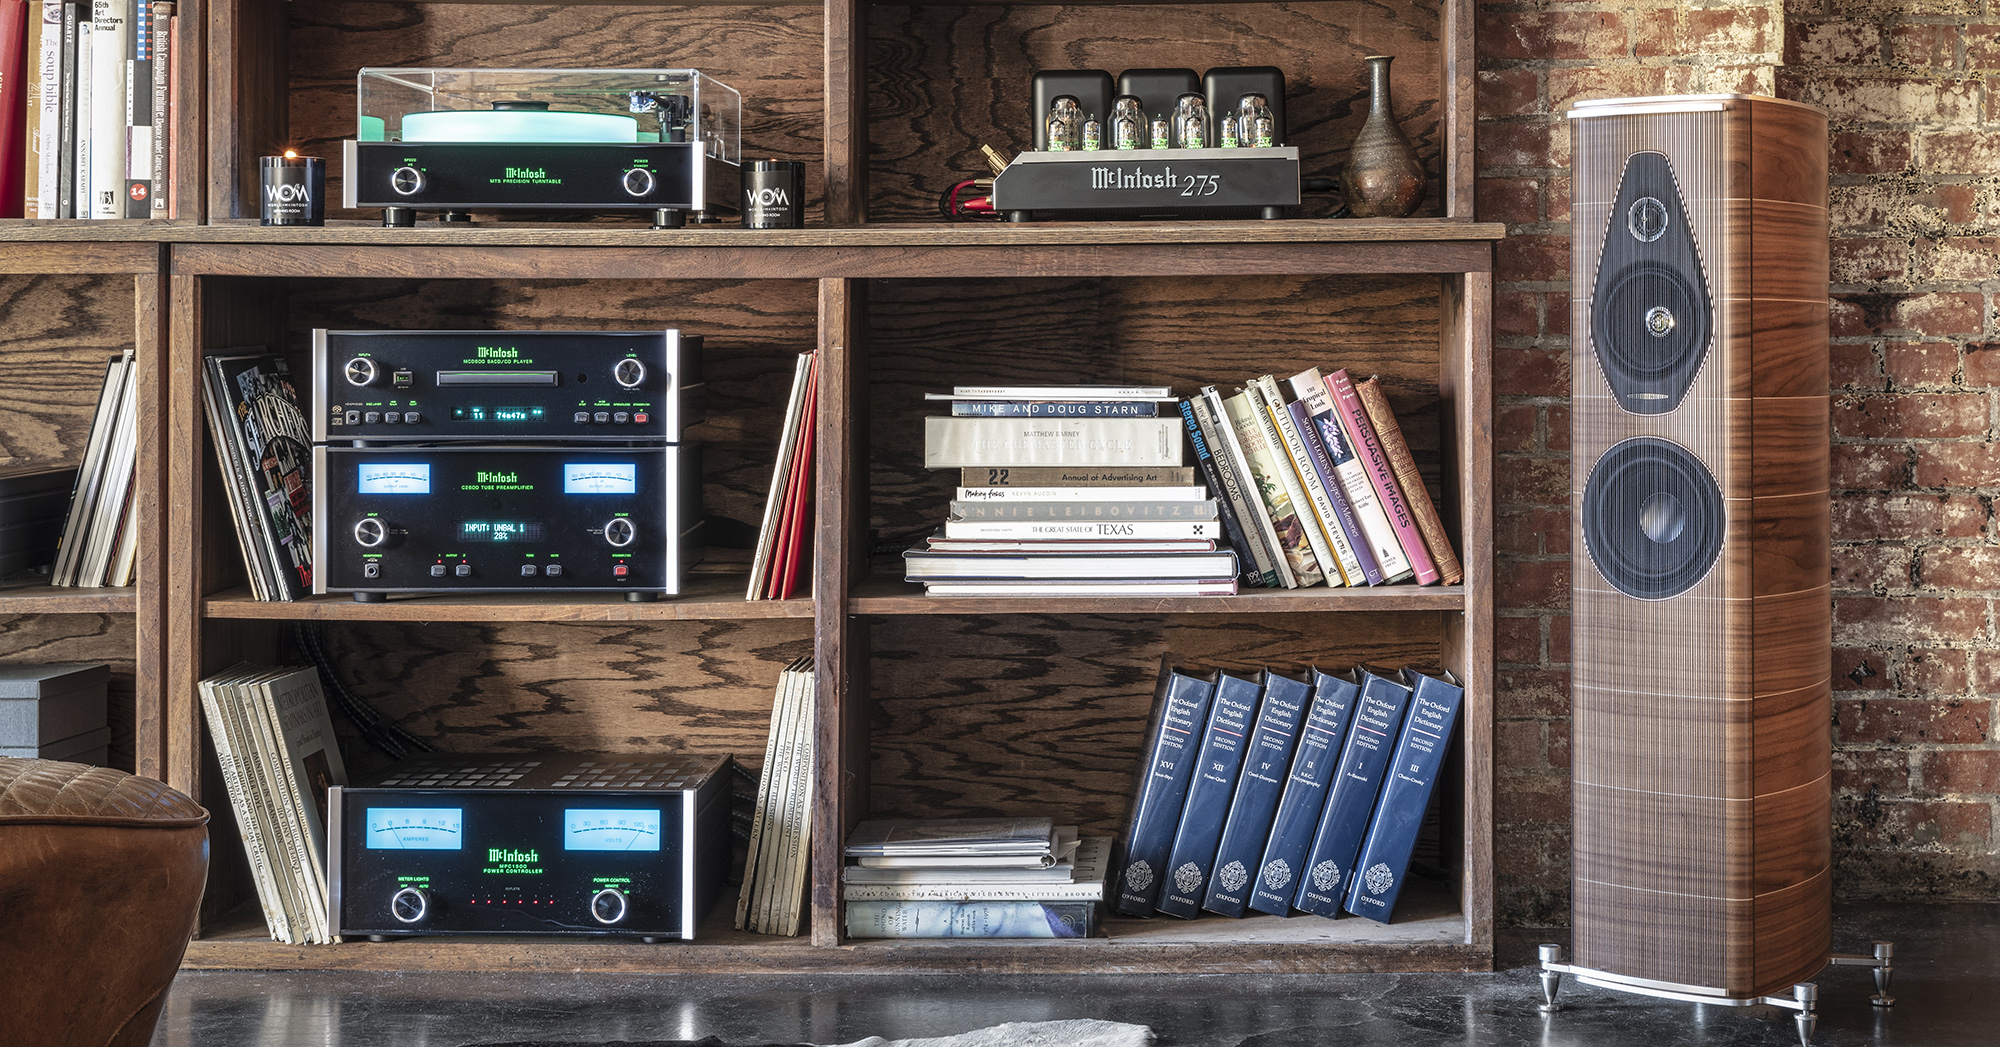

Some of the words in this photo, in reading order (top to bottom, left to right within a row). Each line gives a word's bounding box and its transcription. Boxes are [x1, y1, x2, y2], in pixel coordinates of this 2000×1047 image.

[155, 31, 167, 52] British
[43, 50, 56, 81] soup
[154, 53, 167, 85] Campaign
[45, 83, 58, 112] bible
[155, 86, 167, 117] Furniture:
[154, 118, 163, 138] Elegance
[505, 167, 546, 179] McIntosh
[1091, 166, 1177, 189] McIntosh
[1181, 175, 1221, 196] 275
[131, 187, 146, 196] 14
[478, 347, 518, 358] McIntosh
[1302, 389, 1326, 403] Tropical
[972, 404, 1005, 413] MIKE
[1013, 404, 1040, 413] AND
[1047, 405, 1087, 414] DOUG
[1094, 405, 1138, 414] STARN
[1310, 399, 1326, 411] Look
[244, 391, 313, 471] SEARCHERS
[1179, 400, 1197, 430] Stereo
[1191, 429, 1208, 459] Sound
[1213, 448, 1240, 501] BEDROOMS
[1266, 384, 1275, 397] THE
[1271, 397, 1301, 454] OUTDOOR
[1298, 455, 1318, 491] ROOM
[1317, 496, 1329, 518] DAVID
[1328, 520, 1346, 555] STEVENS
[1351, 409, 1389, 480] PERSUASIVE
[1384, 481, 1409, 528] IMAGES
[477, 472, 518, 483] McIntosh
[989, 469, 1009, 486] 22
[1062, 474, 1089, 482] Annual
[1090, 473, 1099, 482] of
[1101, 473, 1142, 484] Advertising
[1146, 474, 1158, 482] Art
[1302, 417, 1317, 443] SOPHIA
[1326, 474, 1341, 499] Recipes
[1342, 506, 1359, 537] Memories
[964, 489, 987, 500] Making
[960, 507, 1033, 517] ANNIE
[1049, 506, 1181, 516] LEIBOVITZ
[464, 524, 489, 532] INPUT:
[494, 524, 516, 532] UNBAL
[1096, 524, 1134, 536] TEXAS
[494, 532, 508, 540] 28%
[1178, 698, 1198, 709] Oxford
[1220, 697, 1230, 706] The
[1231, 701, 1251, 712] Oxford
[1269, 696, 1279, 705] The
[1279, 700, 1299, 711] Oxford
[1315, 696, 1324, 704] The
[1325, 699, 1345, 710] Oxford
[1365, 695, 1375, 704] The
[1376, 699, 1396, 711] Oxford
[1419, 698, 1429, 707] The
[1430, 701, 1450, 713] Oxford
[1170, 706, 1190, 716] English
[1222, 707, 1243, 719] English
[1271, 706, 1292, 718] English
[1316, 705, 1337, 717] English
[1367, 706, 1388, 718] English
[1421, 708, 1442, 720] English
[1216, 715, 1245, 730] Dictionary
[1264, 715, 1293, 730] Dictionary
[1309, 713, 1338, 729] Dictionary
[1360, 713, 1389, 730] Dictionary
[1414, 716, 1444, 732] Dictionary
[1163, 733, 1184, 743] SECOND
[1214, 736, 1236, 746] SECOND
[1213, 742, 1235, 752] EDITION
[1261, 741, 1283, 751] EDITION
[782, 741, 791, 772] FRESCO
[761, 738, 773, 791] COMPOSITION
[799, 743, 809, 796] COMPOSITION
[218, 751, 236, 804] ABSTRACTION
[242, 755, 255, 789] SUMMER
[253, 791, 261, 810] IDYL
[253, 750, 266, 786] PAINTING
[264, 788, 269, 796] IN
[267, 799, 283, 843] TRANSITION
[759, 793, 763, 803] AS
[797, 799, 802, 808] AS
[237, 770, 247, 795] QUICK
[255, 832, 263, 853] DEAD
[271, 751, 288, 805] COMPOSITION
[286, 807, 292, 817] AS
[290, 819, 305, 864] STRUCTURE
[230, 769, 241, 796] ARTIST
[239, 798, 245, 807] AS
[244, 816, 255, 843] SOCIAL
[252, 845, 262, 870] CRITIC
[752, 805, 761, 839] PATTERN
[791, 811, 800, 858] EXPRESSION
[488, 849, 539, 862] McIntosh
[1122, 893, 1146, 903] OXFORD
[1170, 894, 1194, 905] OXFORD
[1215, 893, 1240, 904] OXFORD
[1258, 890, 1283, 902] OXFORD
[1307, 891, 1332, 903] OXFORD
[1360, 895, 1385, 907] OXFORD
